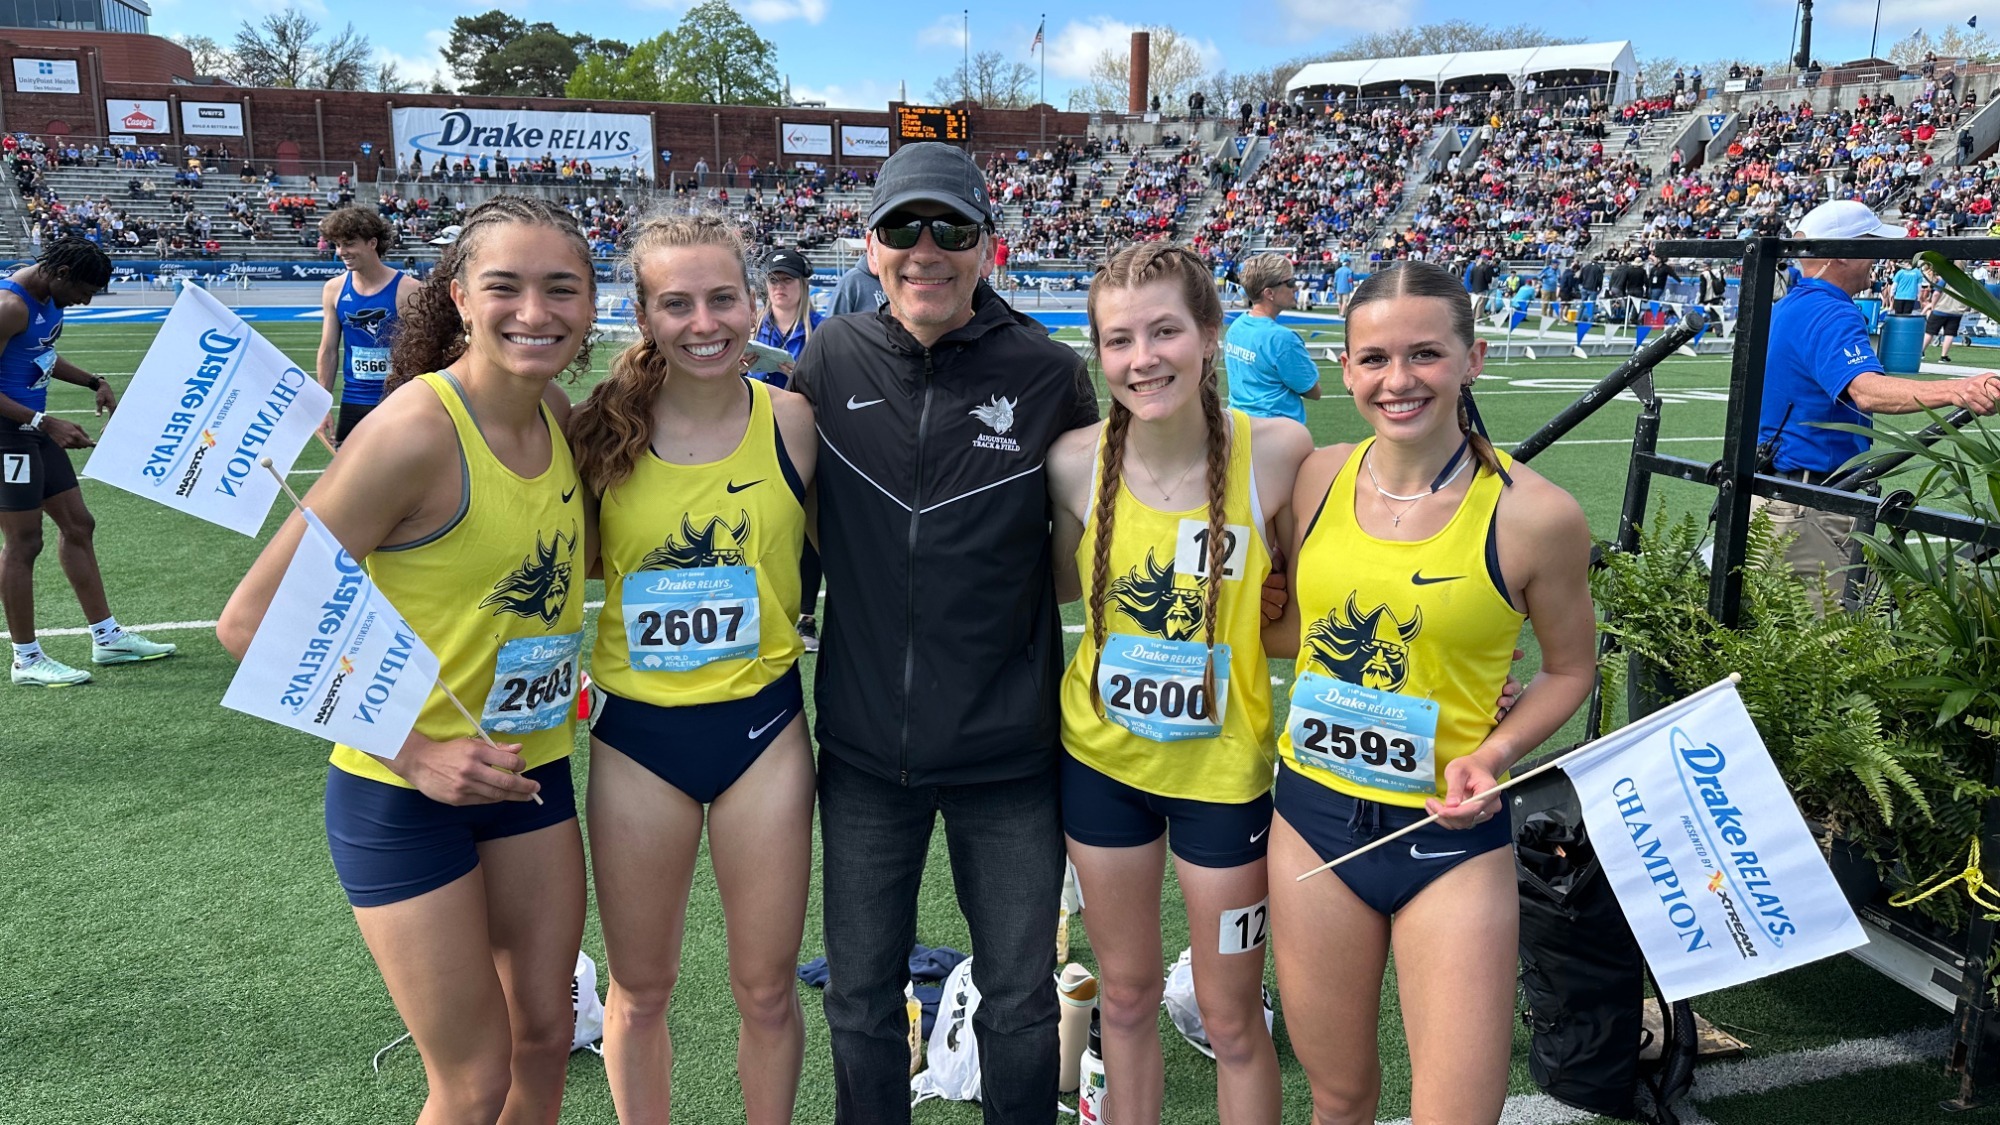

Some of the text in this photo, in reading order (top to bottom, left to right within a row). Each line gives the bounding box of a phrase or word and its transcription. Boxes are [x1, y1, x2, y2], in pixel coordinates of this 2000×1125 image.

[125, 117, 153, 128] Casey's
[437, 111, 630, 151] Drake RELAYS
[112, 266, 135, 275] lays
[230, 263, 257, 272] Drake
[1226, 342, 1257, 362] OLUNTEER
[354, 359, 387, 372] 3566
[972, 440, 994, 449] TRACK
[1000, 444, 1021, 452] FIELD
[9, 456, 24, 481] 7
[1193, 528, 1236, 577] 12
[656, 577, 730, 591] Drake RELAYS
[638, 607, 744, 646] 2607
[665, 660, 700, 668] ATHLETICS
[1131, 644, 1204, 665] Drake RELAYS
[498, 661, 572, 712] 2603
[1110, 674, 1208, 720] 2600
[1325, 688, 1405, 718] Drake RELAYS
[1130, 720, 1152, 730] WORLD
[1131, 726, 1163, 739] ATHLETICS
[1302, 718, 1417, 773] 2593
[1329, 763, 1355, 774] WORLD
[1679, 742, 1796, 936] Drake RELAYS
[1680, 815, 1713, 869] PRESENTED BY
[1612, 777, 1712, 953] CHAMPION
[1234, 905, 1267, 950] 12
[1716, 890, 1758, 957] XTREAM
